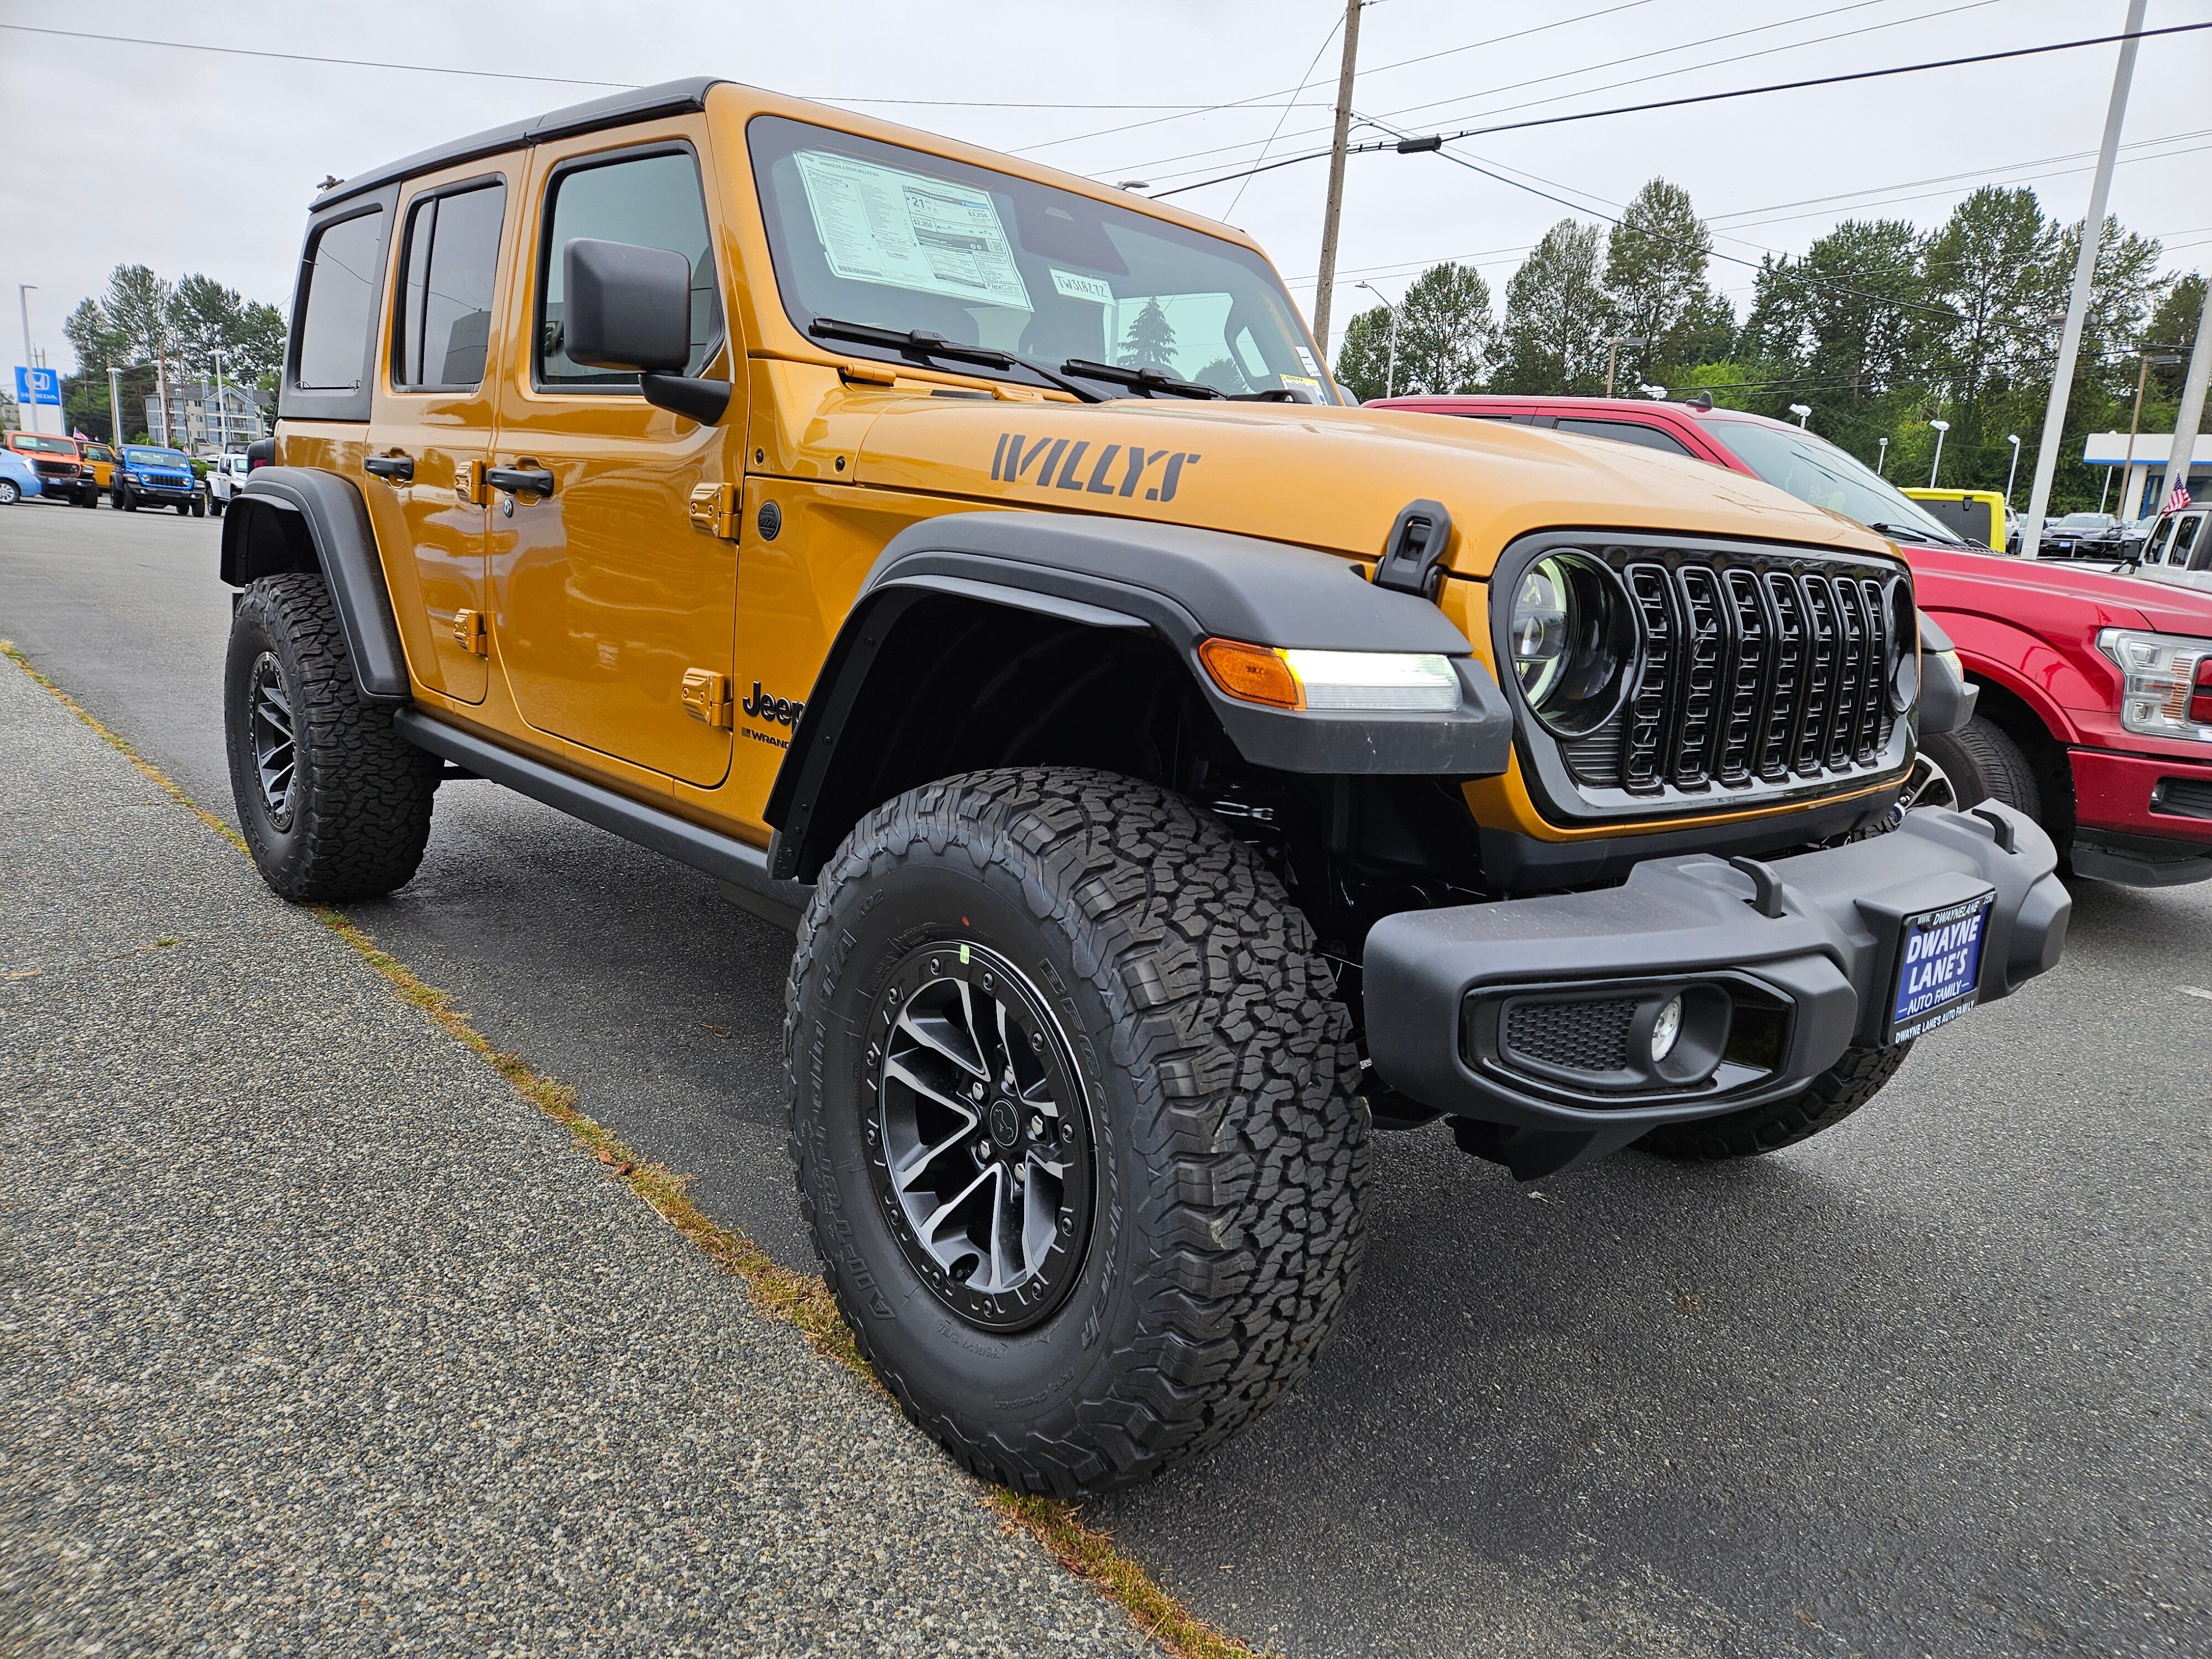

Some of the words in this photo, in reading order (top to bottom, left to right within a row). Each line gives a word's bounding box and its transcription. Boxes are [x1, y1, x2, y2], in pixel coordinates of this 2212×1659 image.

[912, 197, 925, 208] 21
[913, 219, 933, 228] $2,350
[987, 283, 1019, 291] FlexCare
[990, 433, 1202, 502] WILLYS
[743, 680, 806, 734] Jeep
[1933, 900, 1980, 926] DWAYNELANE
[1906, 915, 1980, 964] DWAYNE
[1908, 948, 1968, 995] LANE'S
[1907, 992, 1933, 1015] AUTO
[1933, 979, 1961, 1005] FAMILY
[1895, 1024, 1921, 1044] DWAYNE
[1921, 1015, 1942, 1032] LANE'S
[1942, 1008, 1956, 1025] AUTO
[1955, 999, 1975, 1018] FAMILY
[1039, 957, 1126, 1352] BFGoodrich
